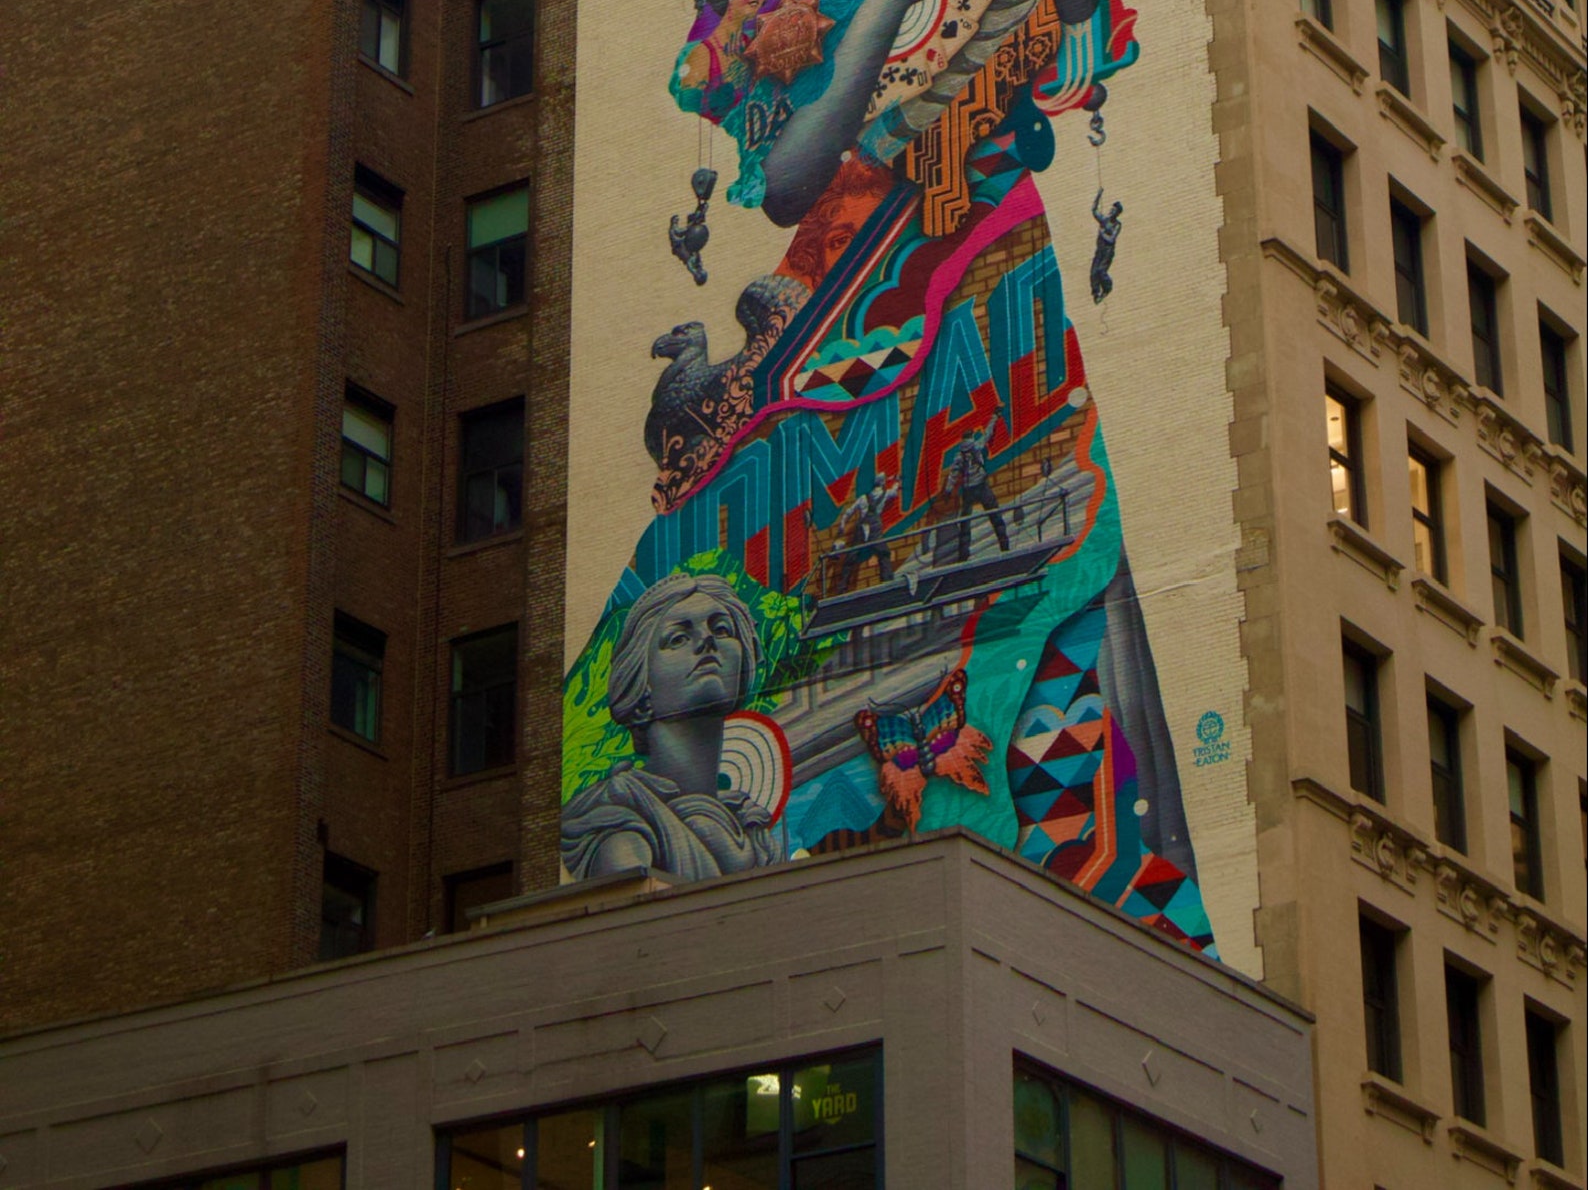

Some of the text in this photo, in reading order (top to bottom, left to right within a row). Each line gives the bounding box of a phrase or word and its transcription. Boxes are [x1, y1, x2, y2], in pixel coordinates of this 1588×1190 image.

[608, 244, 1090, 608] OMAD
[1193, 741, 1231, 757] TRISTAN
[812, 1093, 857, 1119] YARD
